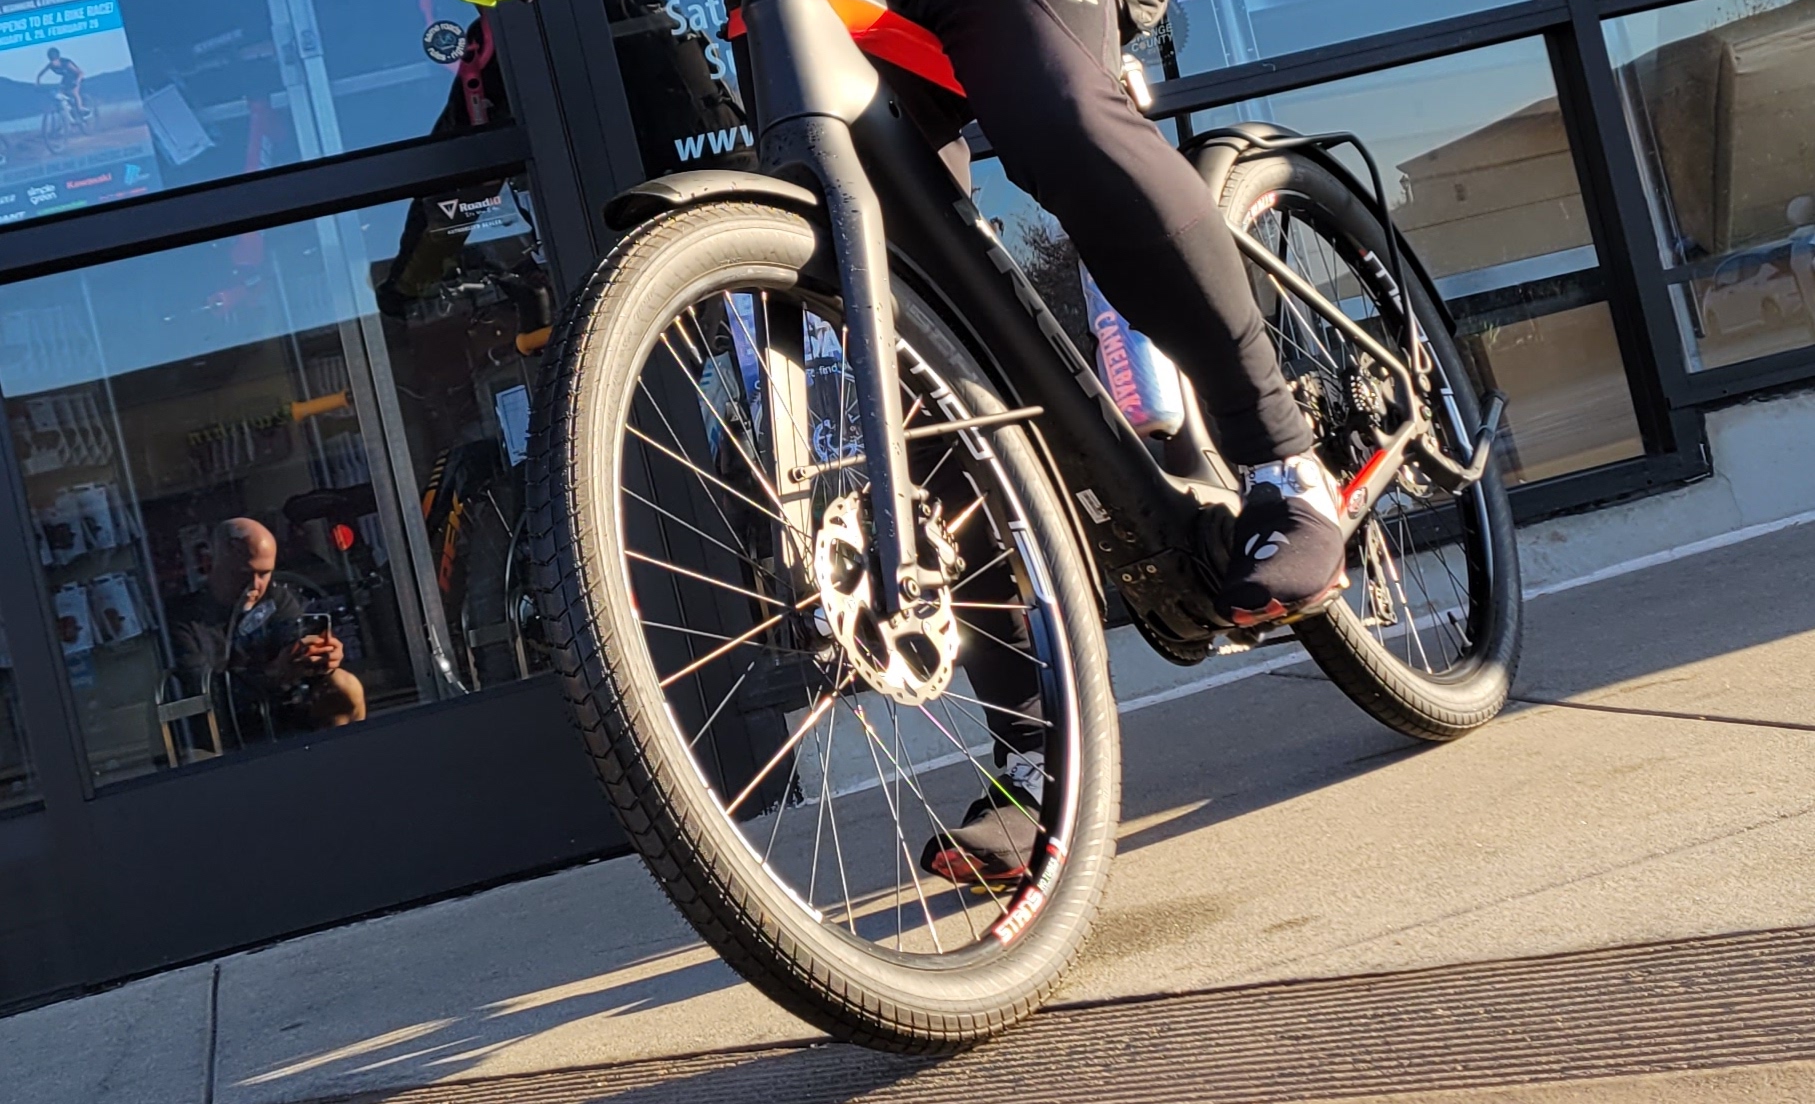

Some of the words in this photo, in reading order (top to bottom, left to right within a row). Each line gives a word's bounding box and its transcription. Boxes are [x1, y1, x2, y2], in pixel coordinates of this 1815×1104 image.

[29, 16, 41, 28] TO
[42, 13, 54, 26] BE
[64, 7, 86, 21] BIKE
[1094, 310, 1142, 412] CAMELBAK
